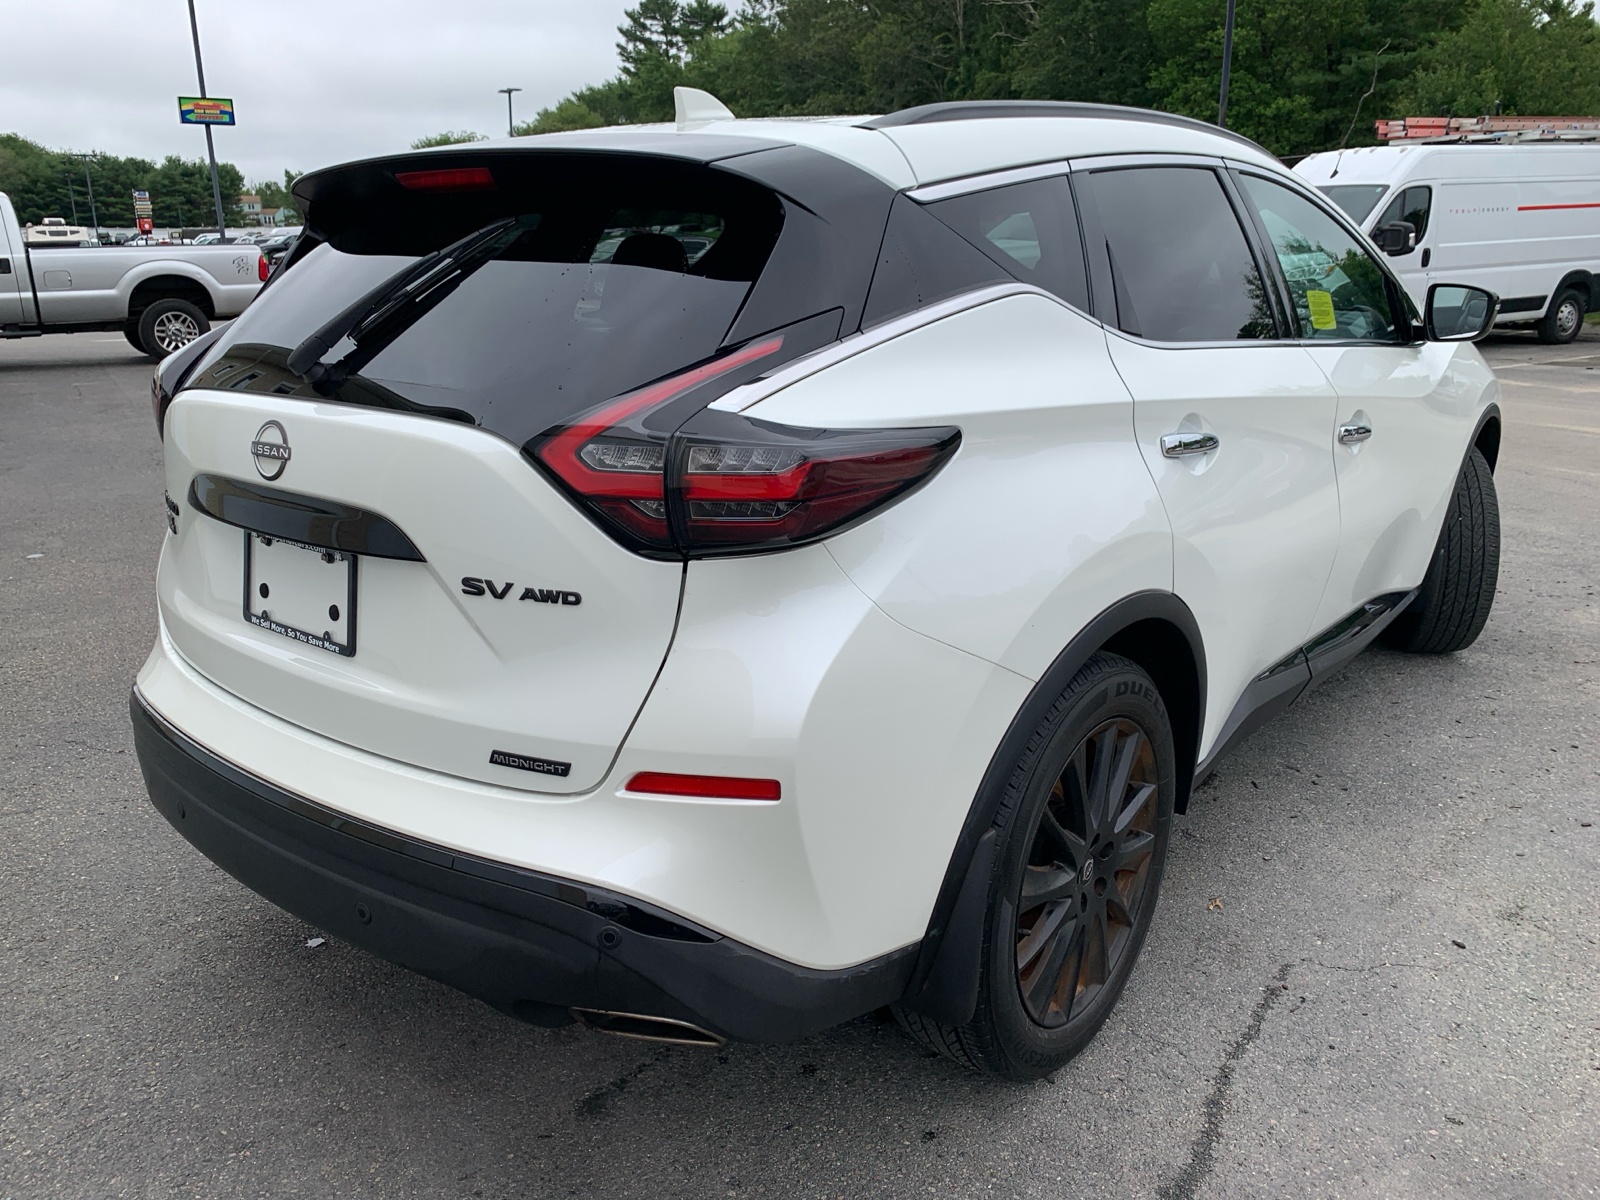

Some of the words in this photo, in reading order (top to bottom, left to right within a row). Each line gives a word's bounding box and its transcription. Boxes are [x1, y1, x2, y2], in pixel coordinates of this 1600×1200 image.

[251, 443, 290, 458] NISSAN
[461, 576, 515, 600] SV
[518, 587, 582, 606] AWD
[251, 616, 259, 625] We
[260, 618, 270, 629] Sell
[271, 623, 287, 636] More,
[287, 628, 295, 637] So
[296, 631, 308, 642] You
[308, 636, 323, 647] Save
[324, 641, 340, 653] More
[493, 754, 565, 773] MIDNIGHT
